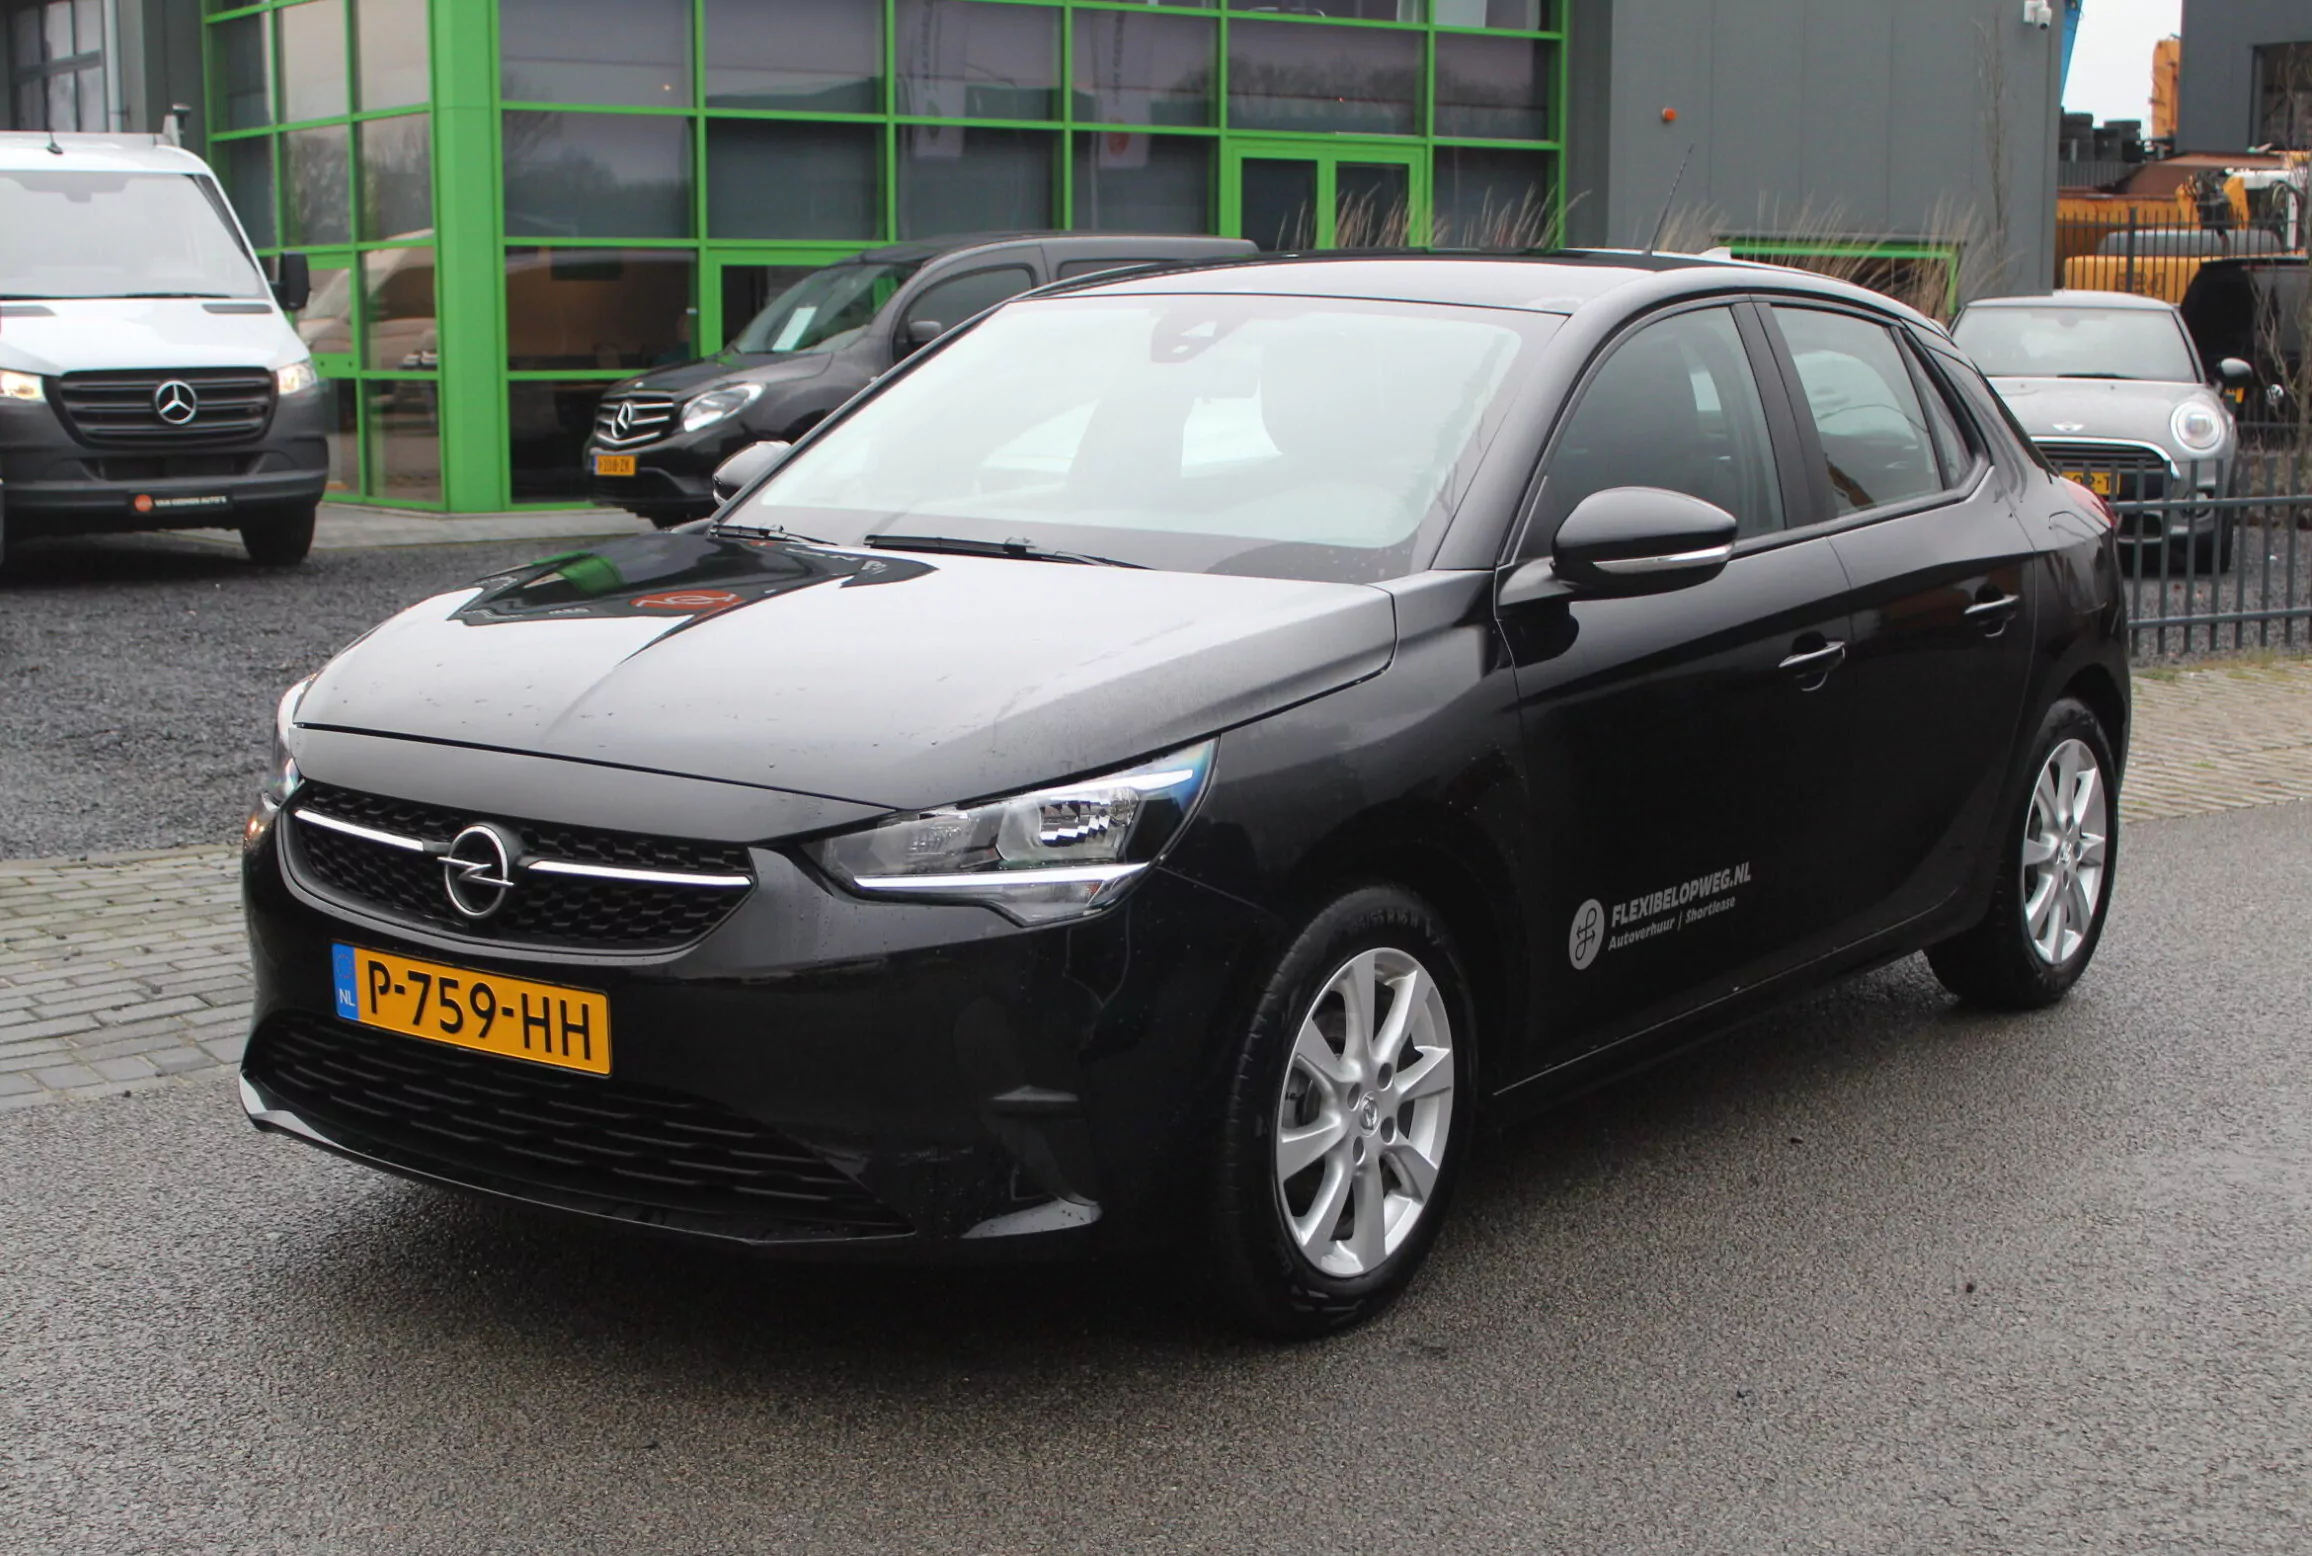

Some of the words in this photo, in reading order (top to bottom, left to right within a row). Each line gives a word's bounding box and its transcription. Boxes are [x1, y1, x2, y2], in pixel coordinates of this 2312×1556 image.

[1608, 917, 1676, 952] Autoverhuur
[1685, 896, 1736, 924] Shortlease
[1611, 861, 1751, 928] FLEXIBELOPWEG.NL
[338, 989, 356, 1008] NL
[367, 960, 591, 1061] P-759-HH
